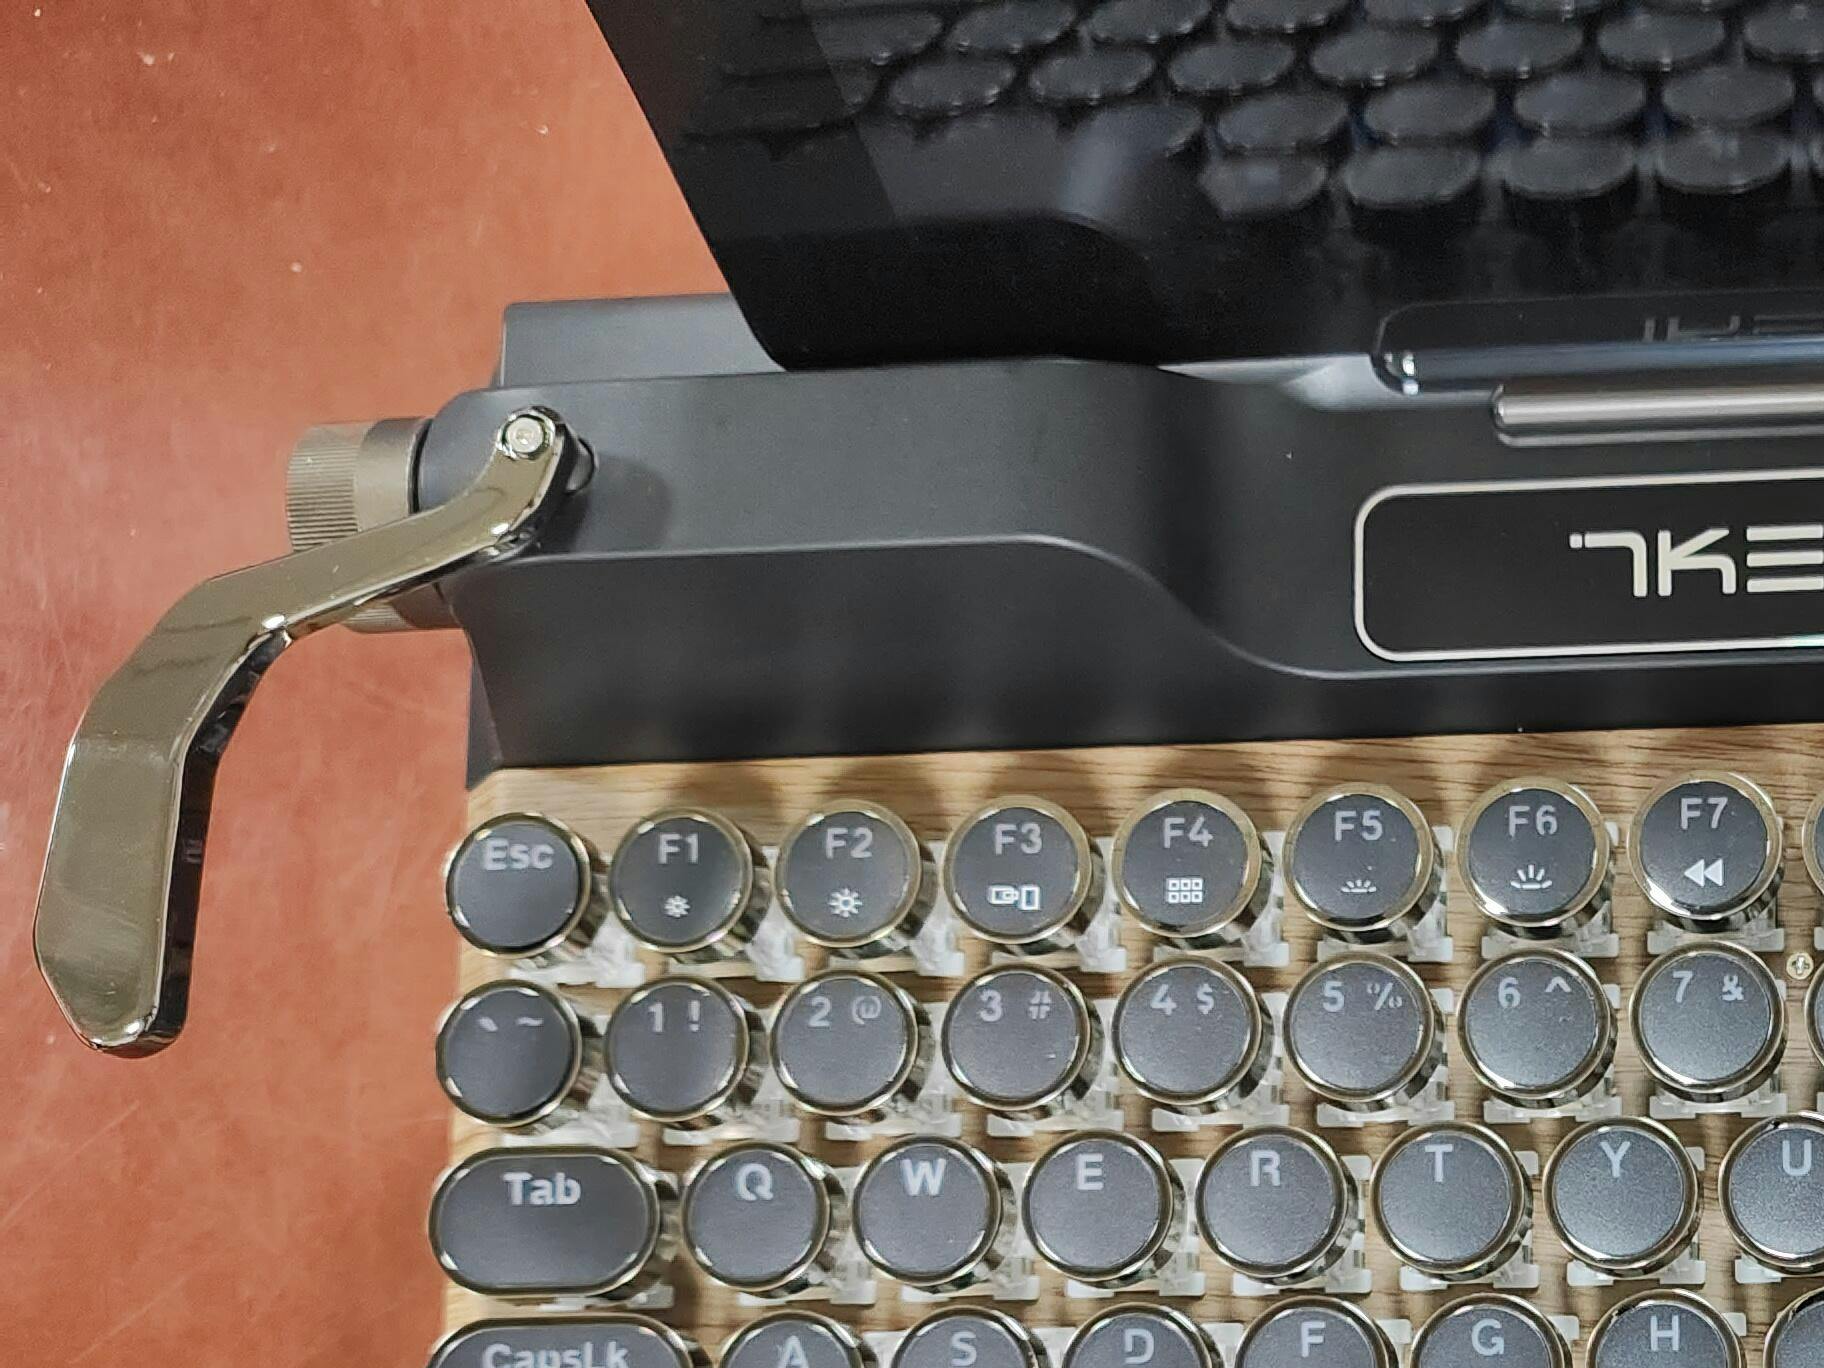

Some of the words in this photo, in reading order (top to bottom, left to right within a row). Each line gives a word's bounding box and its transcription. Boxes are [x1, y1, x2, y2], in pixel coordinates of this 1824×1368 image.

[1335, 810, 1382, 841] F5
[1509, 805, 1557, 837] F6
[1681, 797, 1727, 829] F7
[826, 827, 873, 858] F2
[995, 823, 1042, 854] F3
[1164, 816, 1213, 848] F4
[483, 839, 553, 870] Esc
[659, 834, 698, 863] F1
[1151, 985, 1176, 1015] 4
[1323, 981, 1344, 1012] 5
[1499, 977, 1520, 1009] 6
[1673, 971, 1692, 1003] 7
[649, 1003, 663, 1032] 1
[809, 996, 831, 1027] 2
[979, 990, 1002, 1021] 3
[1077, 1154, 1103, 1190] E
[1251, 1150, 1280, 1186] R
[1425, 1144, 1453, 1182] T
[1601, 1142, 1630, 1177] Y
[1783, 1140, 1811, 1179] U
[503, 1172, 580, 1205] Tab
[737, 1164, 773, 1200] Q
[903, 1158, 946, 1195] W
[951, 1331, 976, 1366] S
[1125, 1329, 1154, 1364] D
[1301, 1321, 1325, 1357] F
[1472, 1319, 1504, 1355] G
[1651, 1316, 1679, 1351] H
